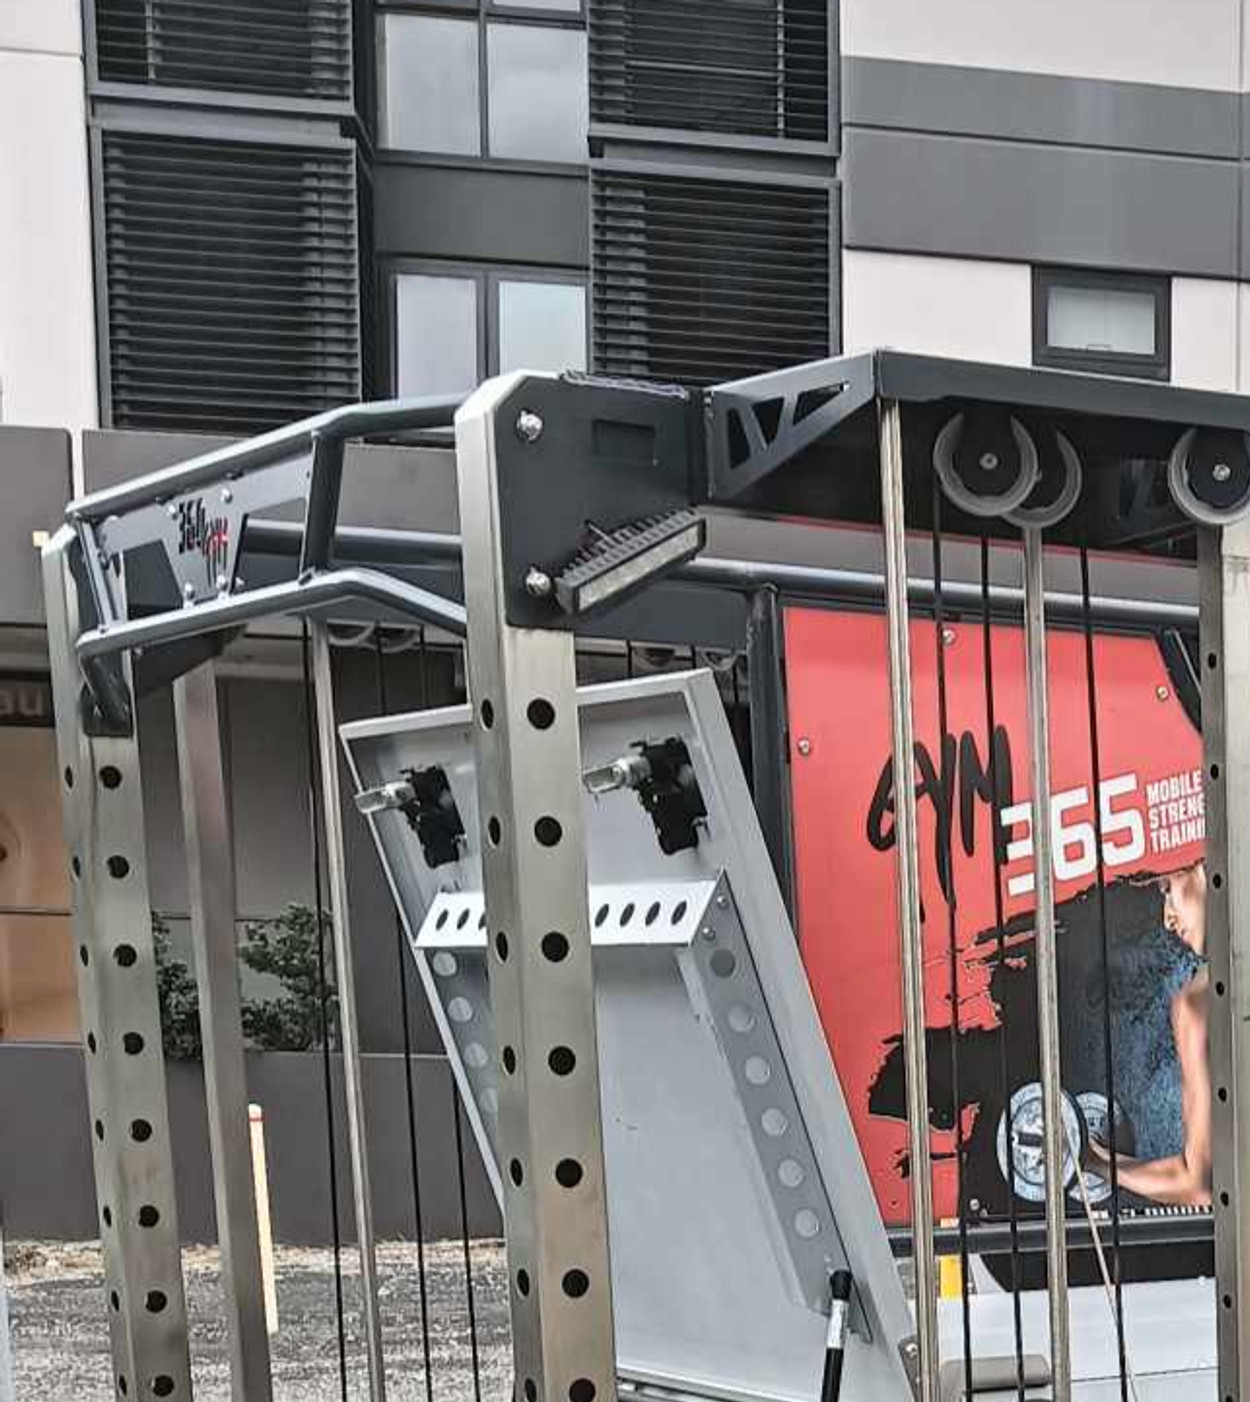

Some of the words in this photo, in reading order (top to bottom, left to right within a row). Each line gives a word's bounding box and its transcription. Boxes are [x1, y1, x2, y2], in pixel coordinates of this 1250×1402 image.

[867, 724, 1014, 923] GYM
[1000, 772, 1146, 896] 365
[1146, 769, 1202, 807] MOBILE
